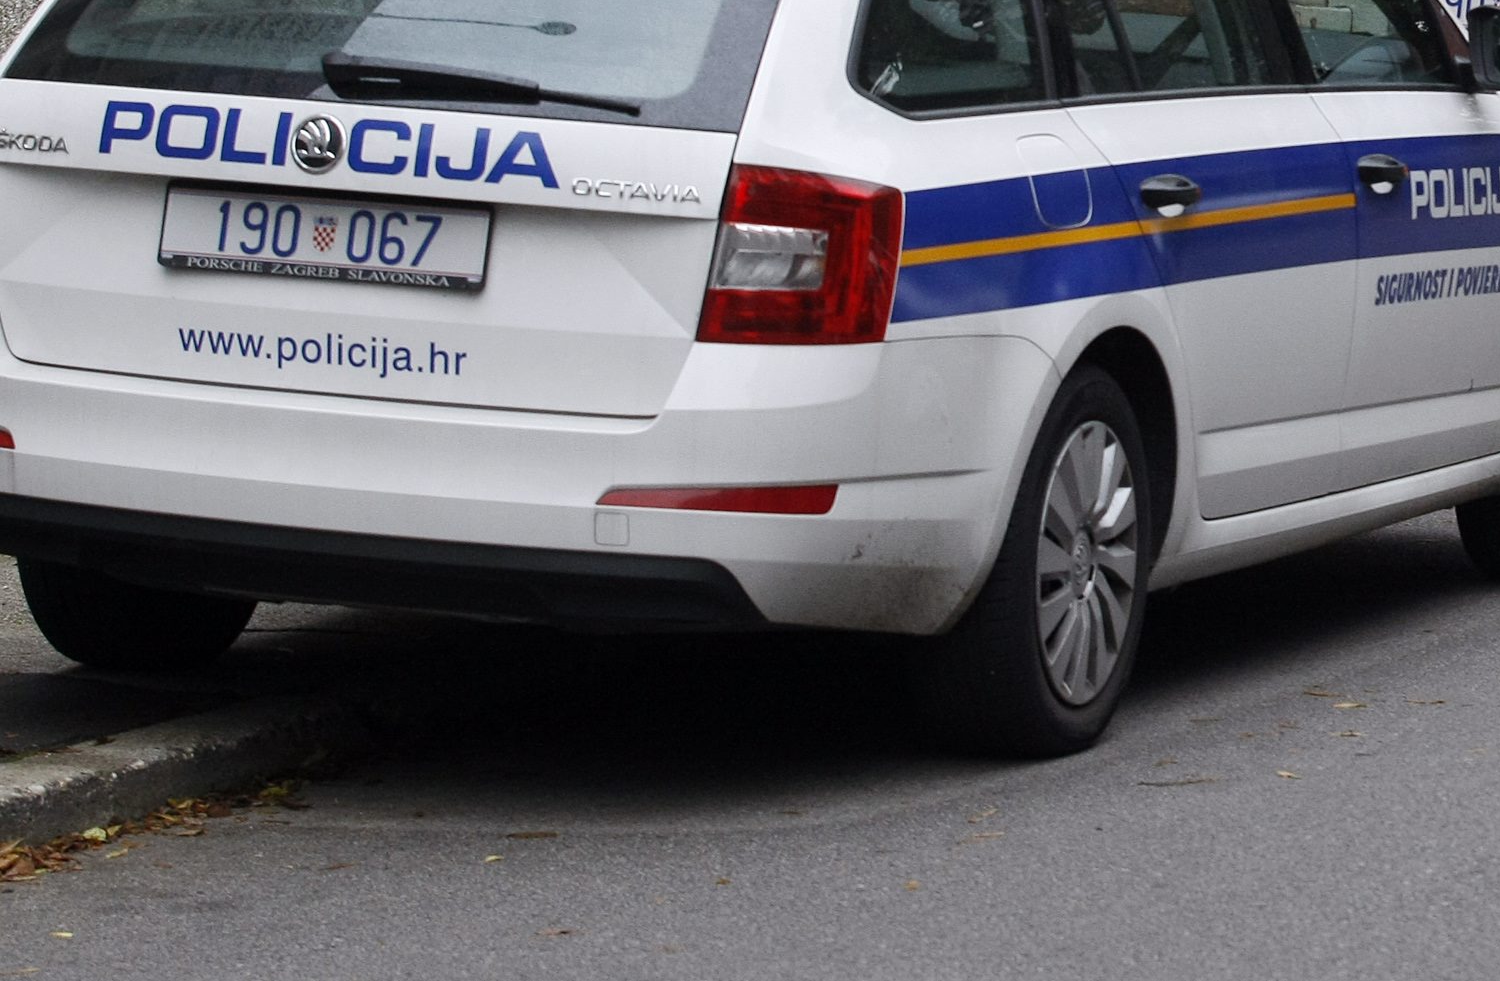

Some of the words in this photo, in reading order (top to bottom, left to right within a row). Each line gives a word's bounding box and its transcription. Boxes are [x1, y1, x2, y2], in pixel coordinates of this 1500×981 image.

[99, 100, 559, 189] POLICIJA
[572, 177, 702, 204] OCTAVIA
[218, 200, 302, 258] 190
[346, 209, 444, 268] 067
[187, 256, 264, 273] PORSCHE
[271, 263, 340, 280] ZAGREB
[347, 270, 450, 287] SLAVONSKA
[1374, 269, 1447, 306] SIGURNOST
[1447, 268, 1455, 297] I
[179, 325, 468, 378] www.policija.hr
